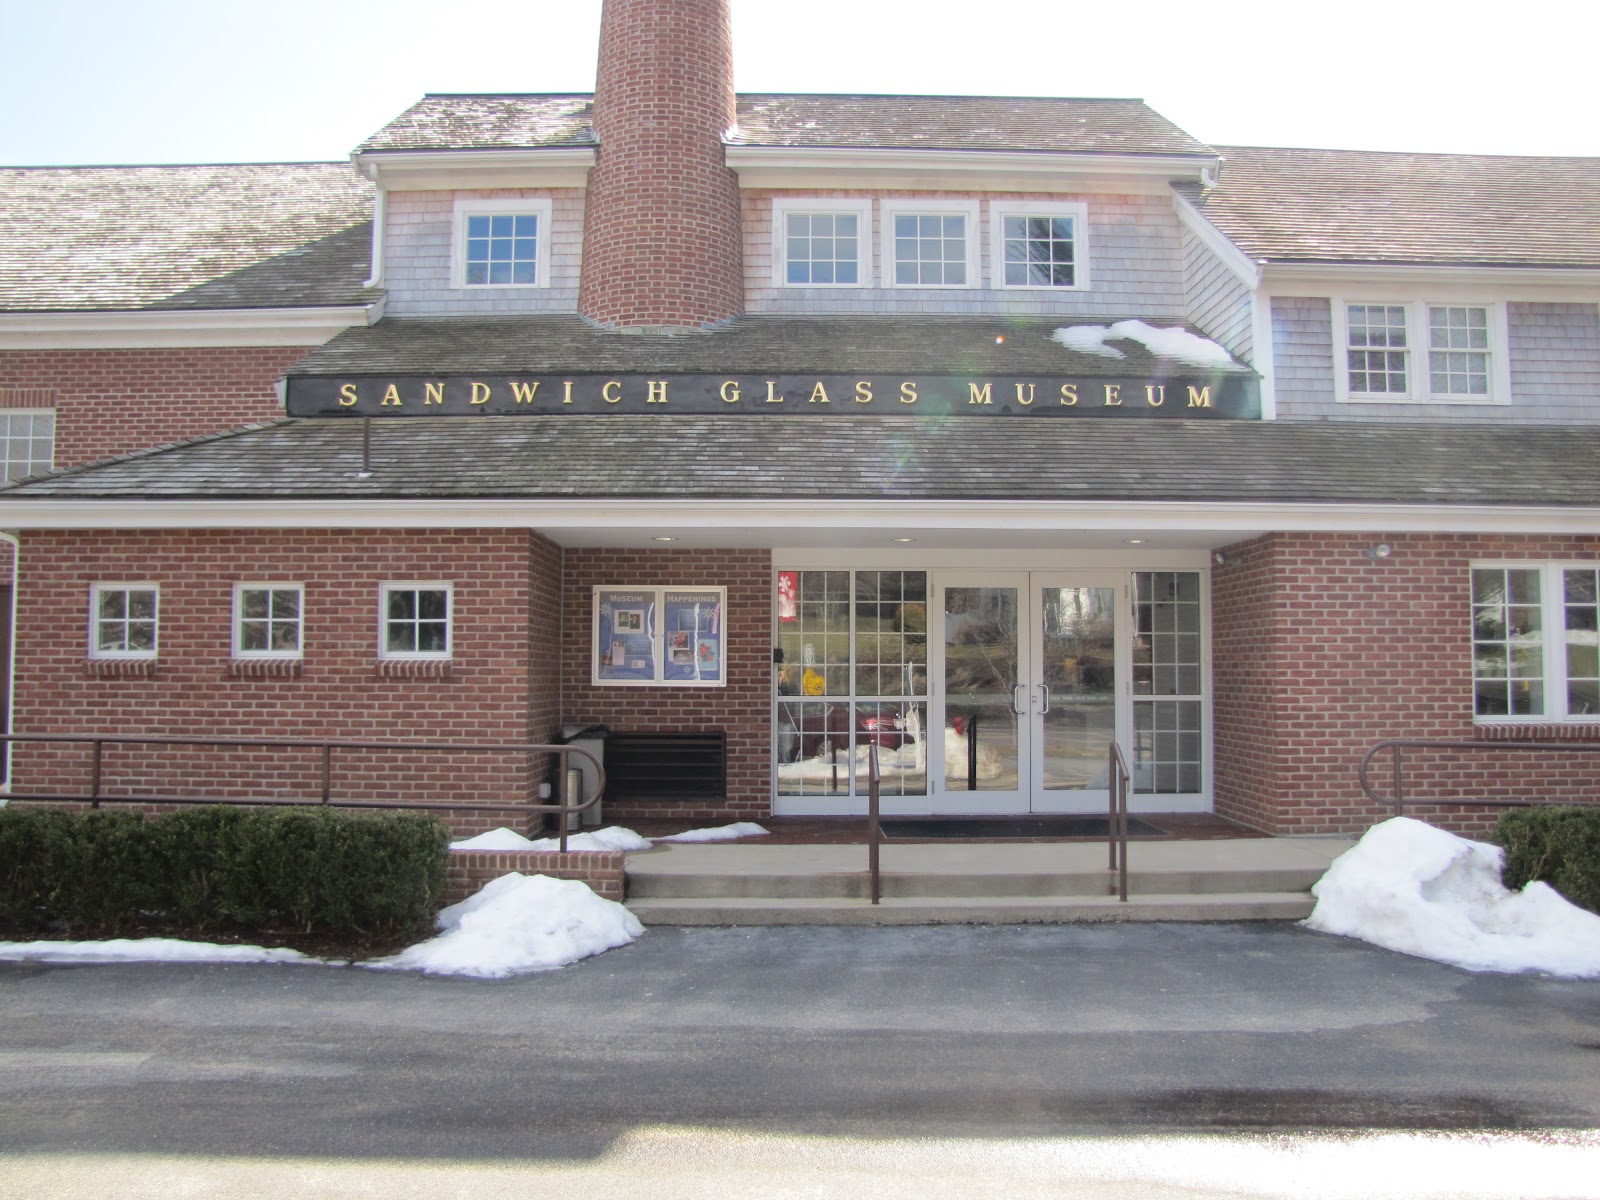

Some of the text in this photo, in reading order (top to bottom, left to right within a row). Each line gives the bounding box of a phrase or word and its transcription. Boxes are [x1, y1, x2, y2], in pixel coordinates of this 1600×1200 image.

[338, 380, 1213, 408] SANDWICH GLASS MUSEUM
[610, 594, 717, 603] MUSEUM HAPPENINGS
